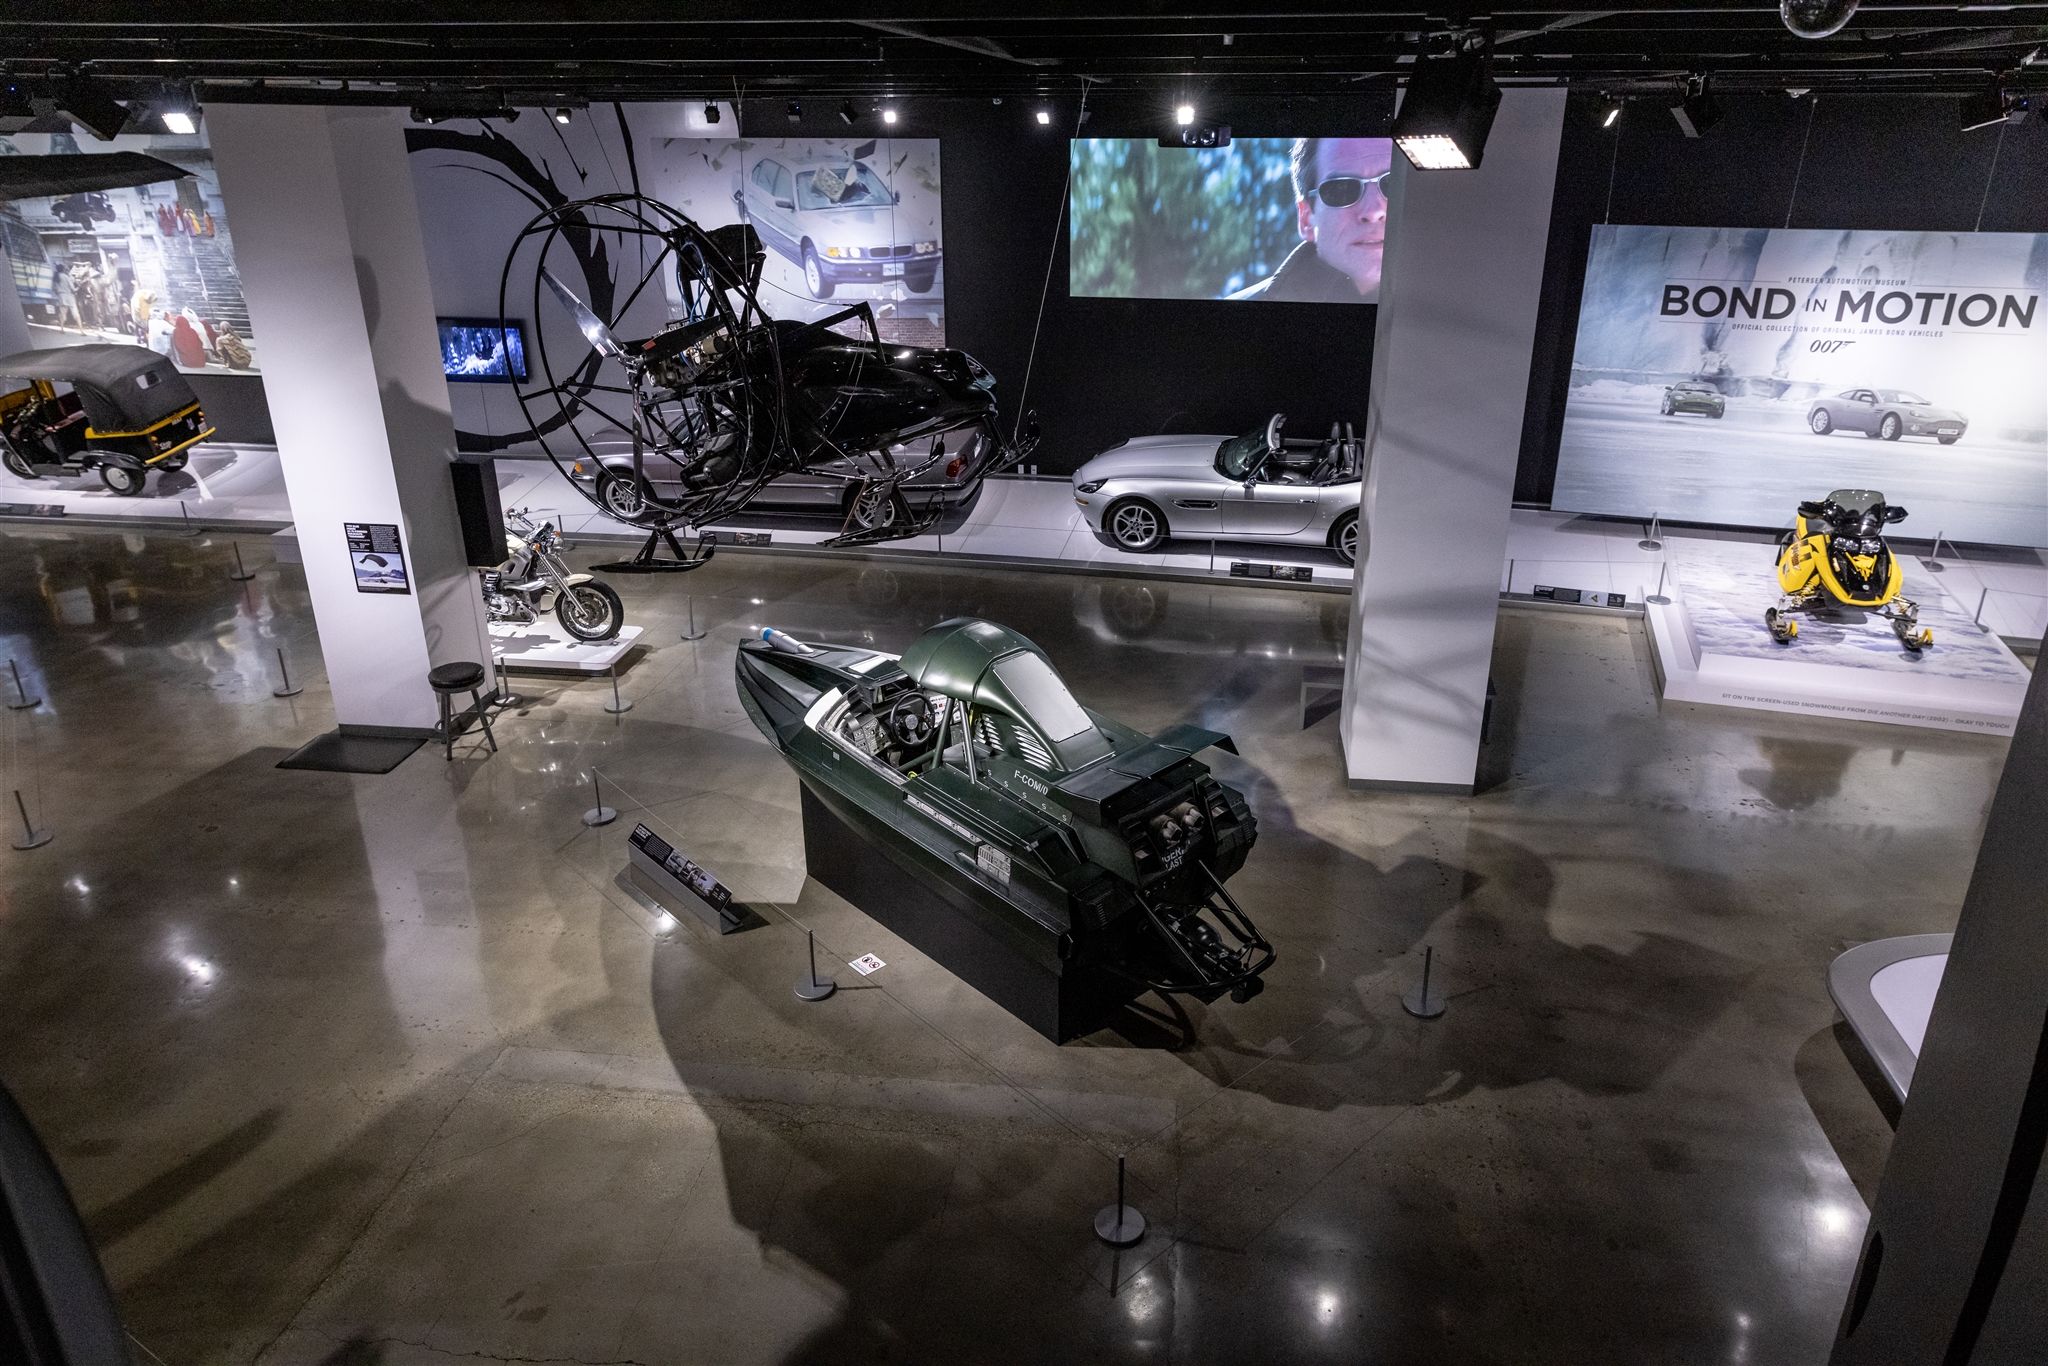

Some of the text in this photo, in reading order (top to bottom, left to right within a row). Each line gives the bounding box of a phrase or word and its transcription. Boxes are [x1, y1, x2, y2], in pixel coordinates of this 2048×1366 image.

[1787, 276, 1824, 284] PETERSEN
[1826, 277, 1872, 286] AUTOMOTIVE
[1660, 284, 2039, 329] BOND IN MOTION
[1732, 323, 1763, 331] OFFICIAL
[1765, 324, 1809, 333] COLLECTION
[1823, 326, 1856, 334] ORIGINAL
[1908, 330, 1944, 338] VEHICLES
[1809, 339, 1845, 353] 007
[1757, 697, 1800, 706] SCREEN-USED
[1801, 702, 1845, 712] SNOWMOBILE
[1847, 706, 1866, 714] FROM
[1879, 710, 1911, 719] ANOTHER
[1955, 718, 1975, 726] OKAY
[1986, 721, 2010, 729] TOUCH
